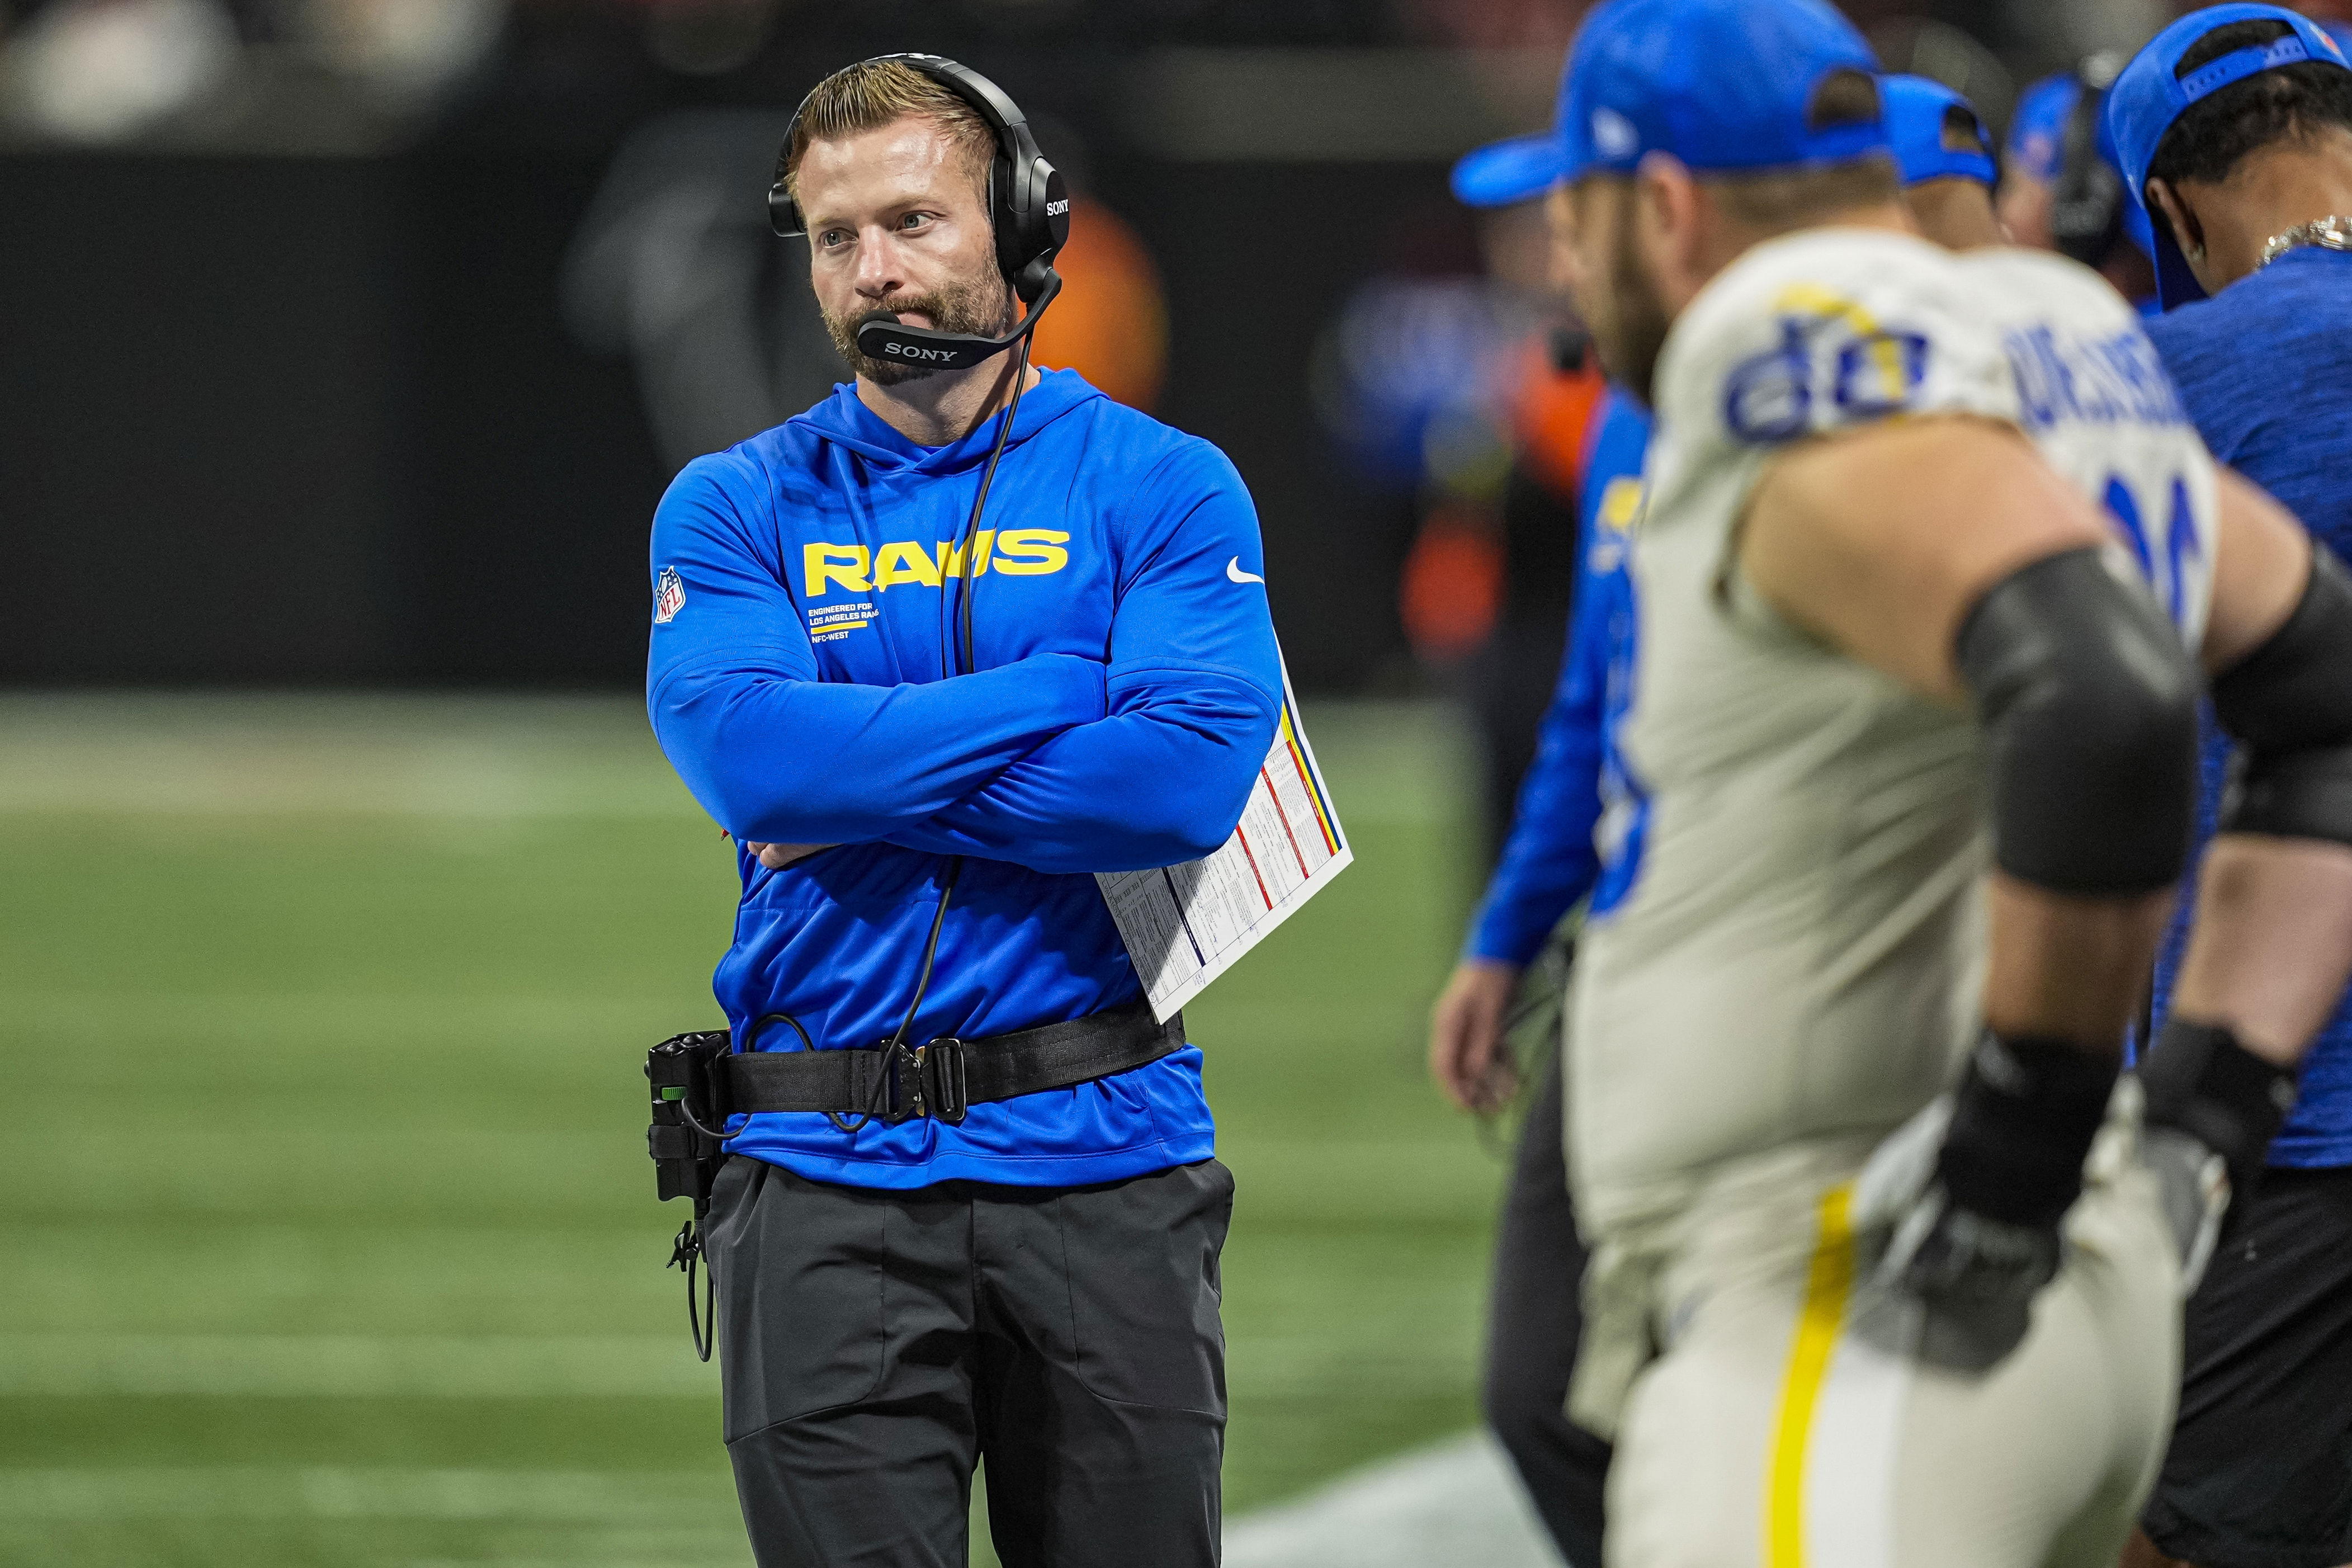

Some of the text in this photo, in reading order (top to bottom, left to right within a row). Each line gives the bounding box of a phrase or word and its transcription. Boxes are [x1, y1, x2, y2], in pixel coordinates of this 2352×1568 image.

[1046, 199, 1069, 216] SONY
[884, 342, 957, 362] SONY
[803, 528, 1070, 597] RAMS
[660, 587, 681, 620] NFL
[808, 602, 873, 617] ENGINEERED FOR
[809, 617, 824, 626] LOS
[824, 612, 860, 624] ANGELES
[811, 631, 849, 644] NFC-WEST
